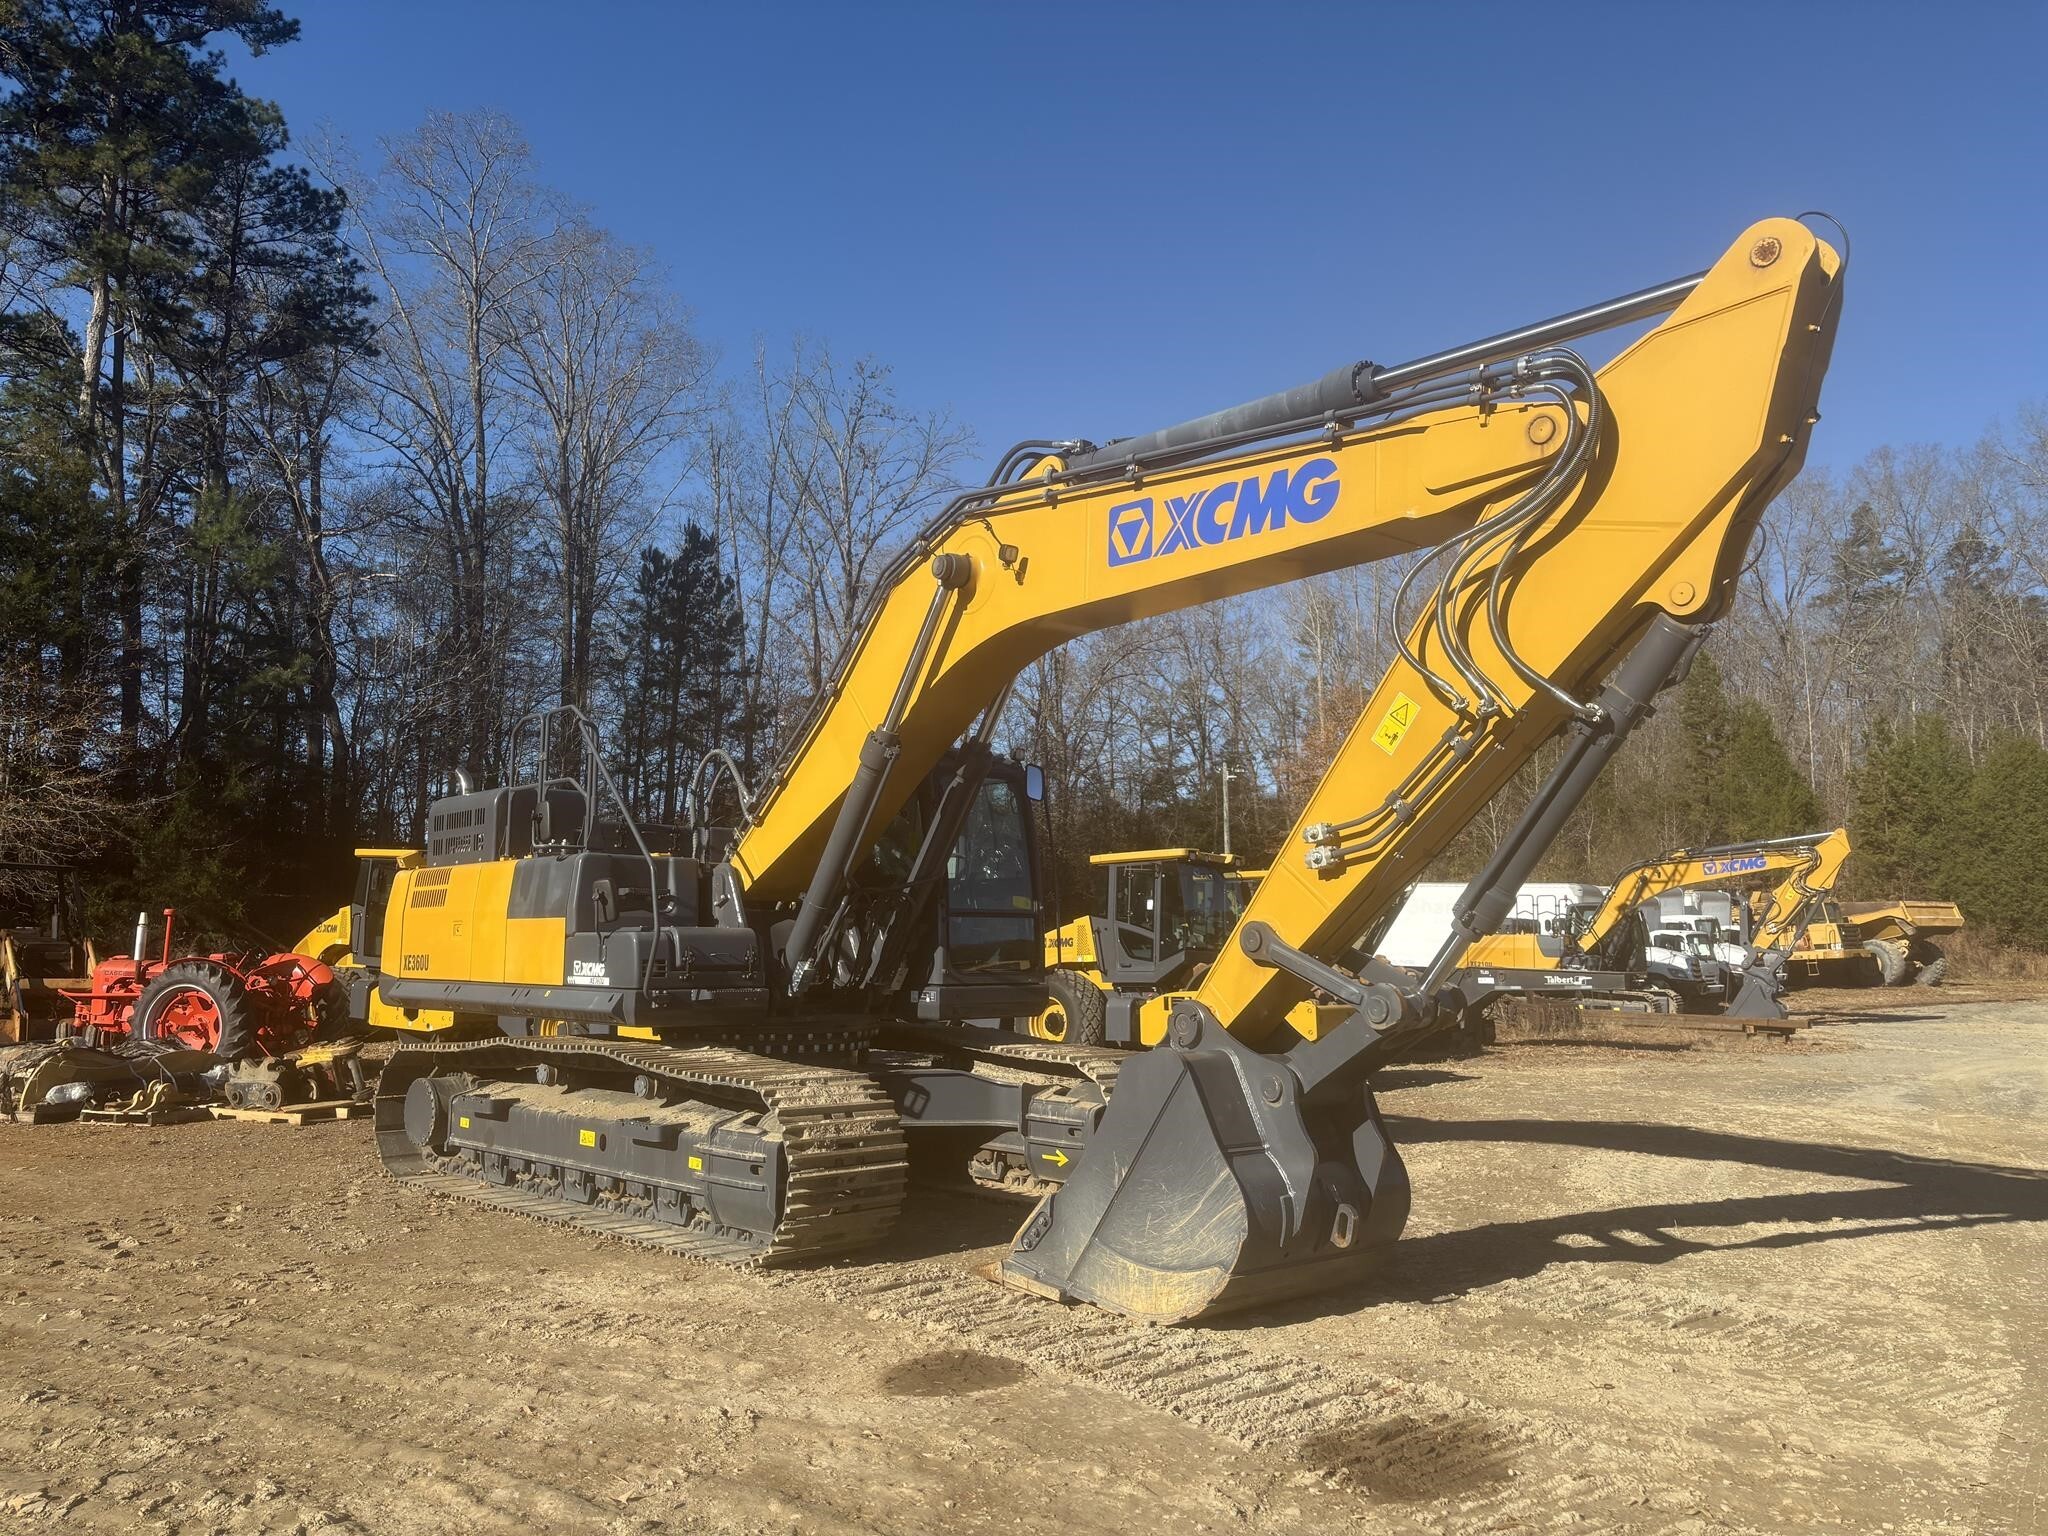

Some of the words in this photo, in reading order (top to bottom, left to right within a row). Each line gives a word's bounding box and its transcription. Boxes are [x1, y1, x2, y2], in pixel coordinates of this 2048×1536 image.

[1152, 458, 1341, 558] XCMG
[1720, 856, 1767, 873] XCMG
[403, 954, 430, 971] XE360U
[580, 962, 606, 977] XCMG
[1544, 975, 1574, 984] Talbert
